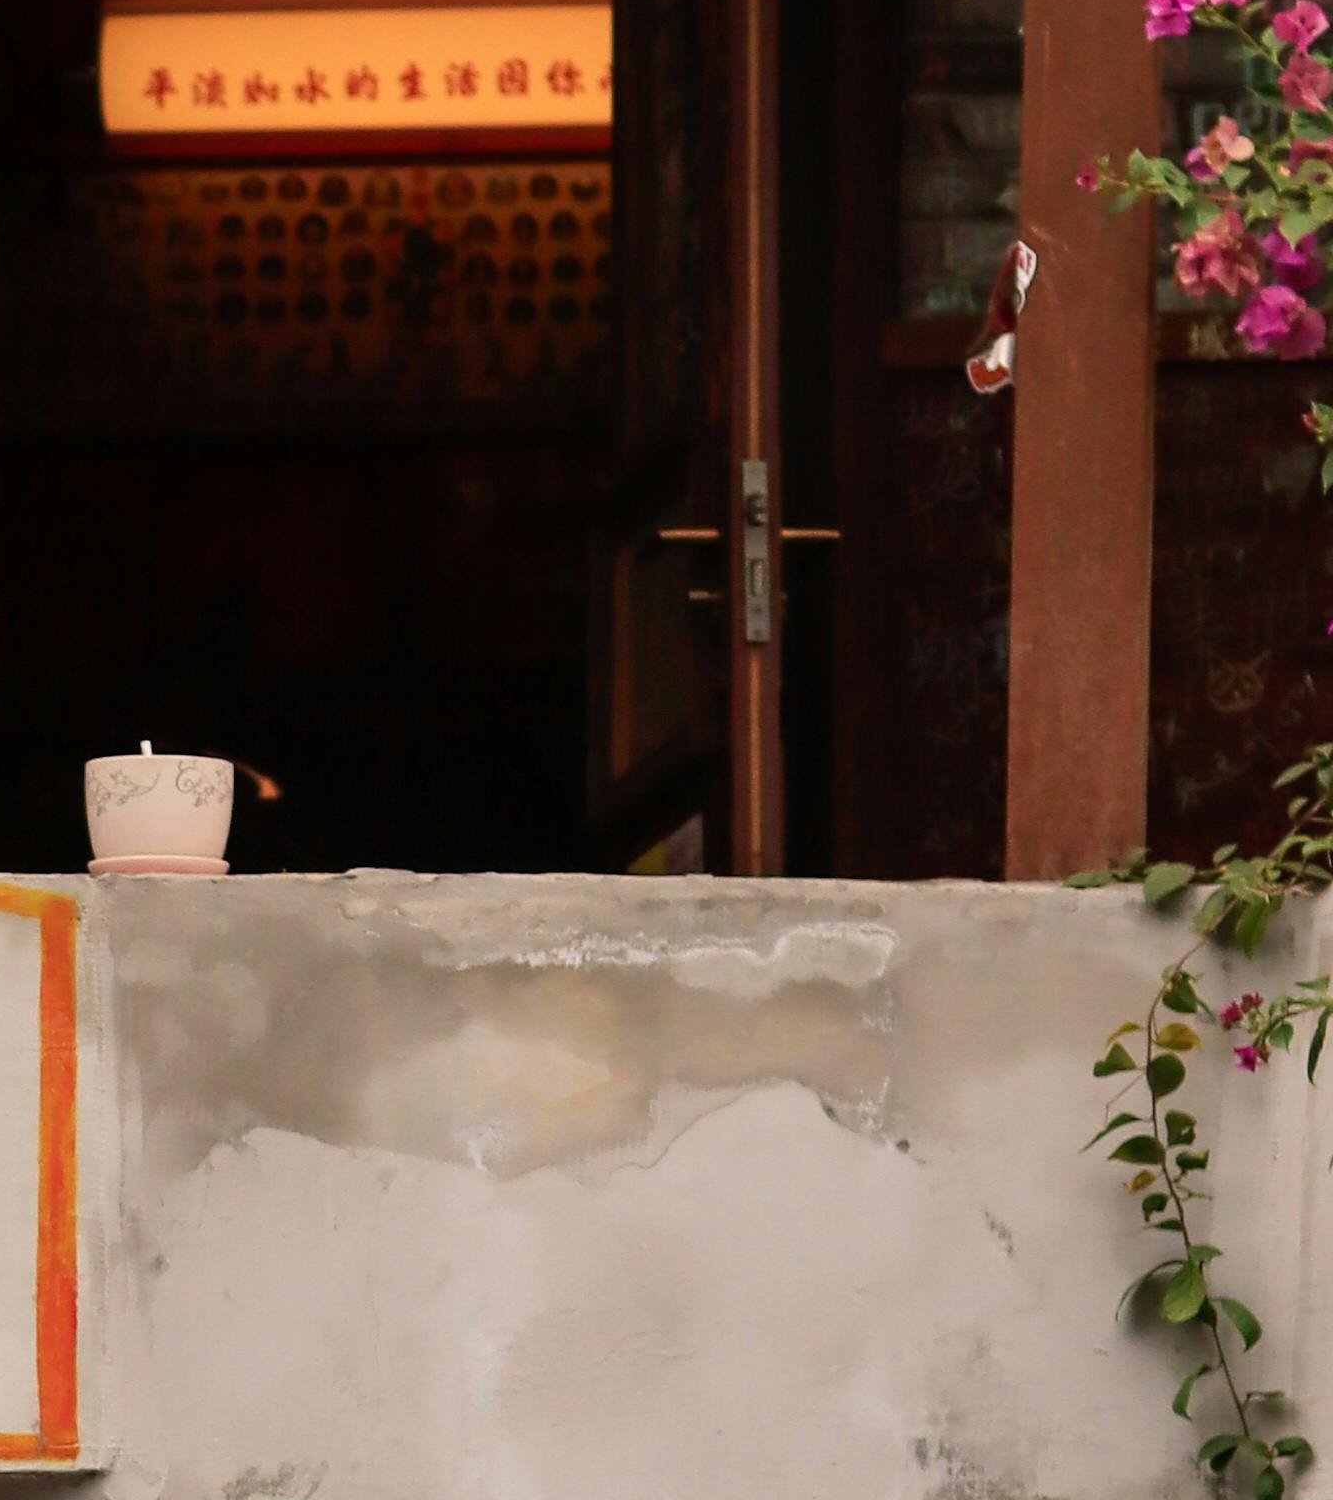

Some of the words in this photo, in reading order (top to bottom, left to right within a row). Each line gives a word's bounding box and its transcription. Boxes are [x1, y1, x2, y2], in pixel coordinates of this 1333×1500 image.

[143, 59, 612, 108] 平淡如水的生活因你
